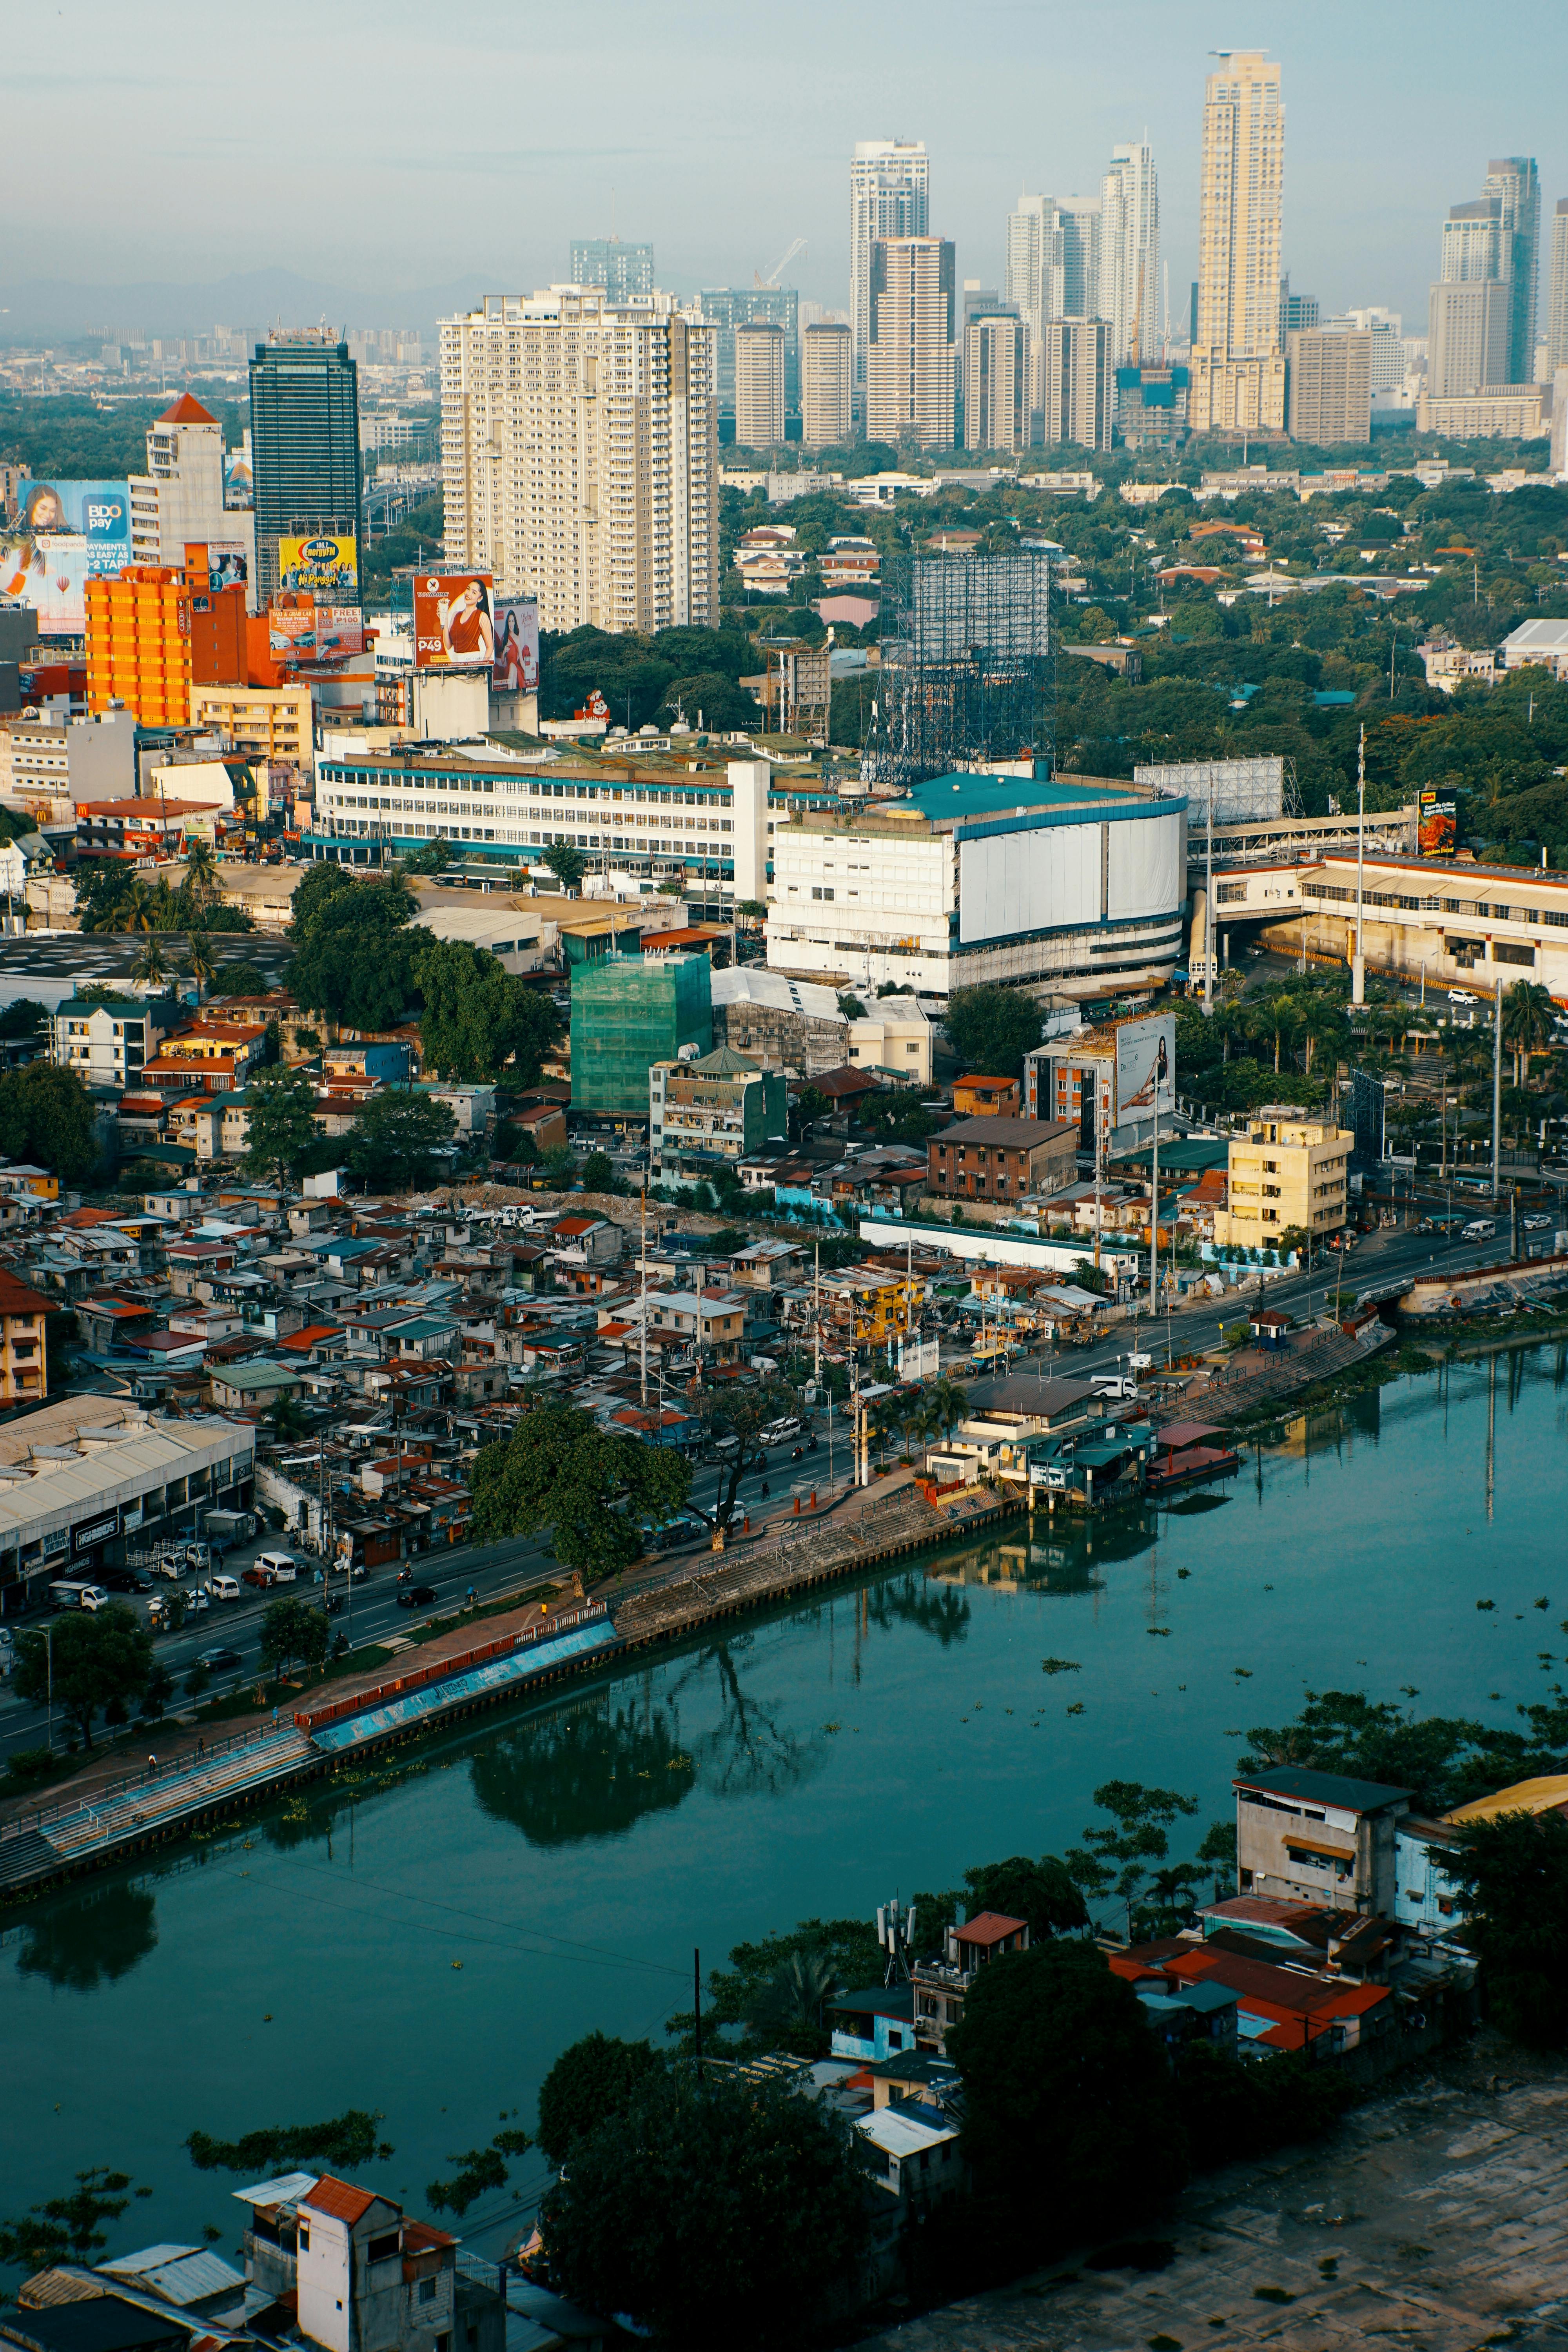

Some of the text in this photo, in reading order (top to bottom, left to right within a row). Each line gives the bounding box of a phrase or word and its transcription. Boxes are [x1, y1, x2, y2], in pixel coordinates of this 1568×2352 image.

[89, 505, 122, 517] BDO
[89, 519, 112, 530] pay
[305, 547, 336, 557] EnergyFM
[102, 560, 127, 569] TAP!
[298, 572, 336, 586] Hi Pangga!
